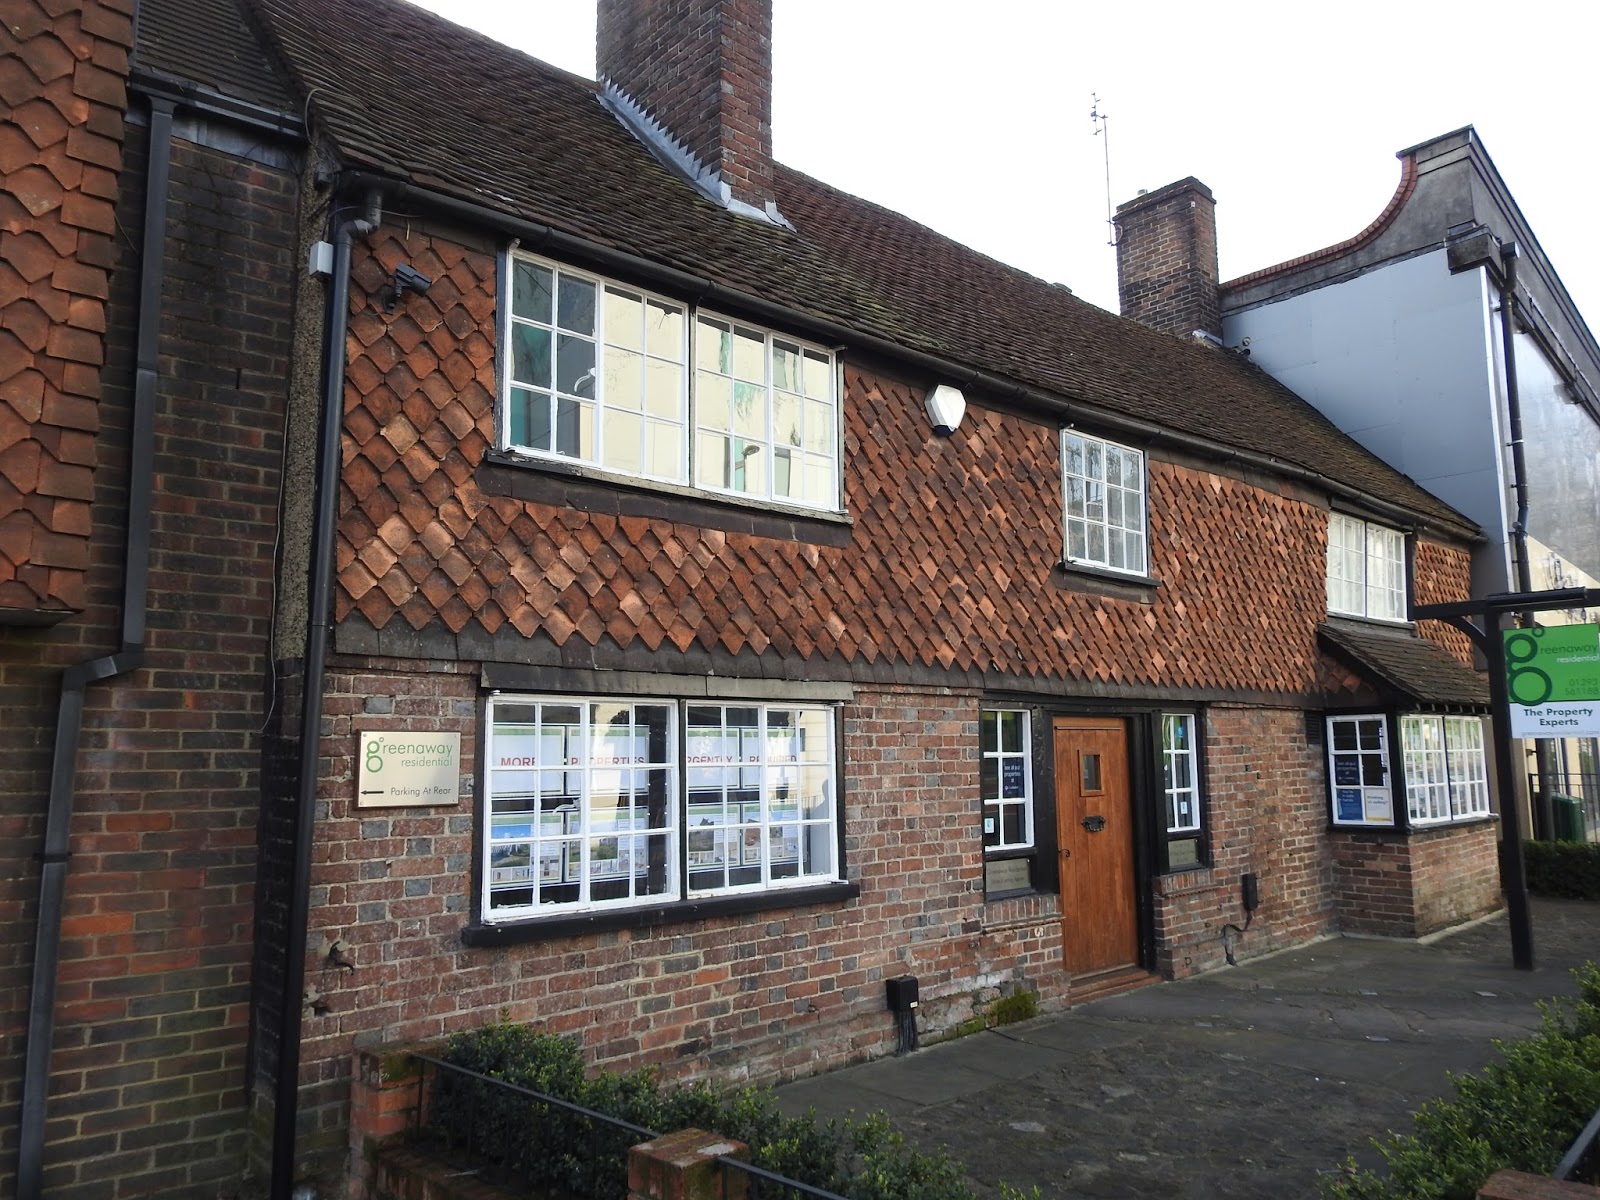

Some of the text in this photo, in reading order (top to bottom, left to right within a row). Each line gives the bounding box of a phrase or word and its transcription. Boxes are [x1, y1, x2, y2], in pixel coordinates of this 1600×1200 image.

[1556, 653, 1600, 663] residential
[1523, 708, 1593, 717] The Property
[1539, 718, 1579, 727] Experts
[366, 740, 453, 773] greenaway
[401, 756, 453, 767] residential
[571, 756, 645, 766] POPERTIS
[390, 786, 451, 798] Parking At Rear
